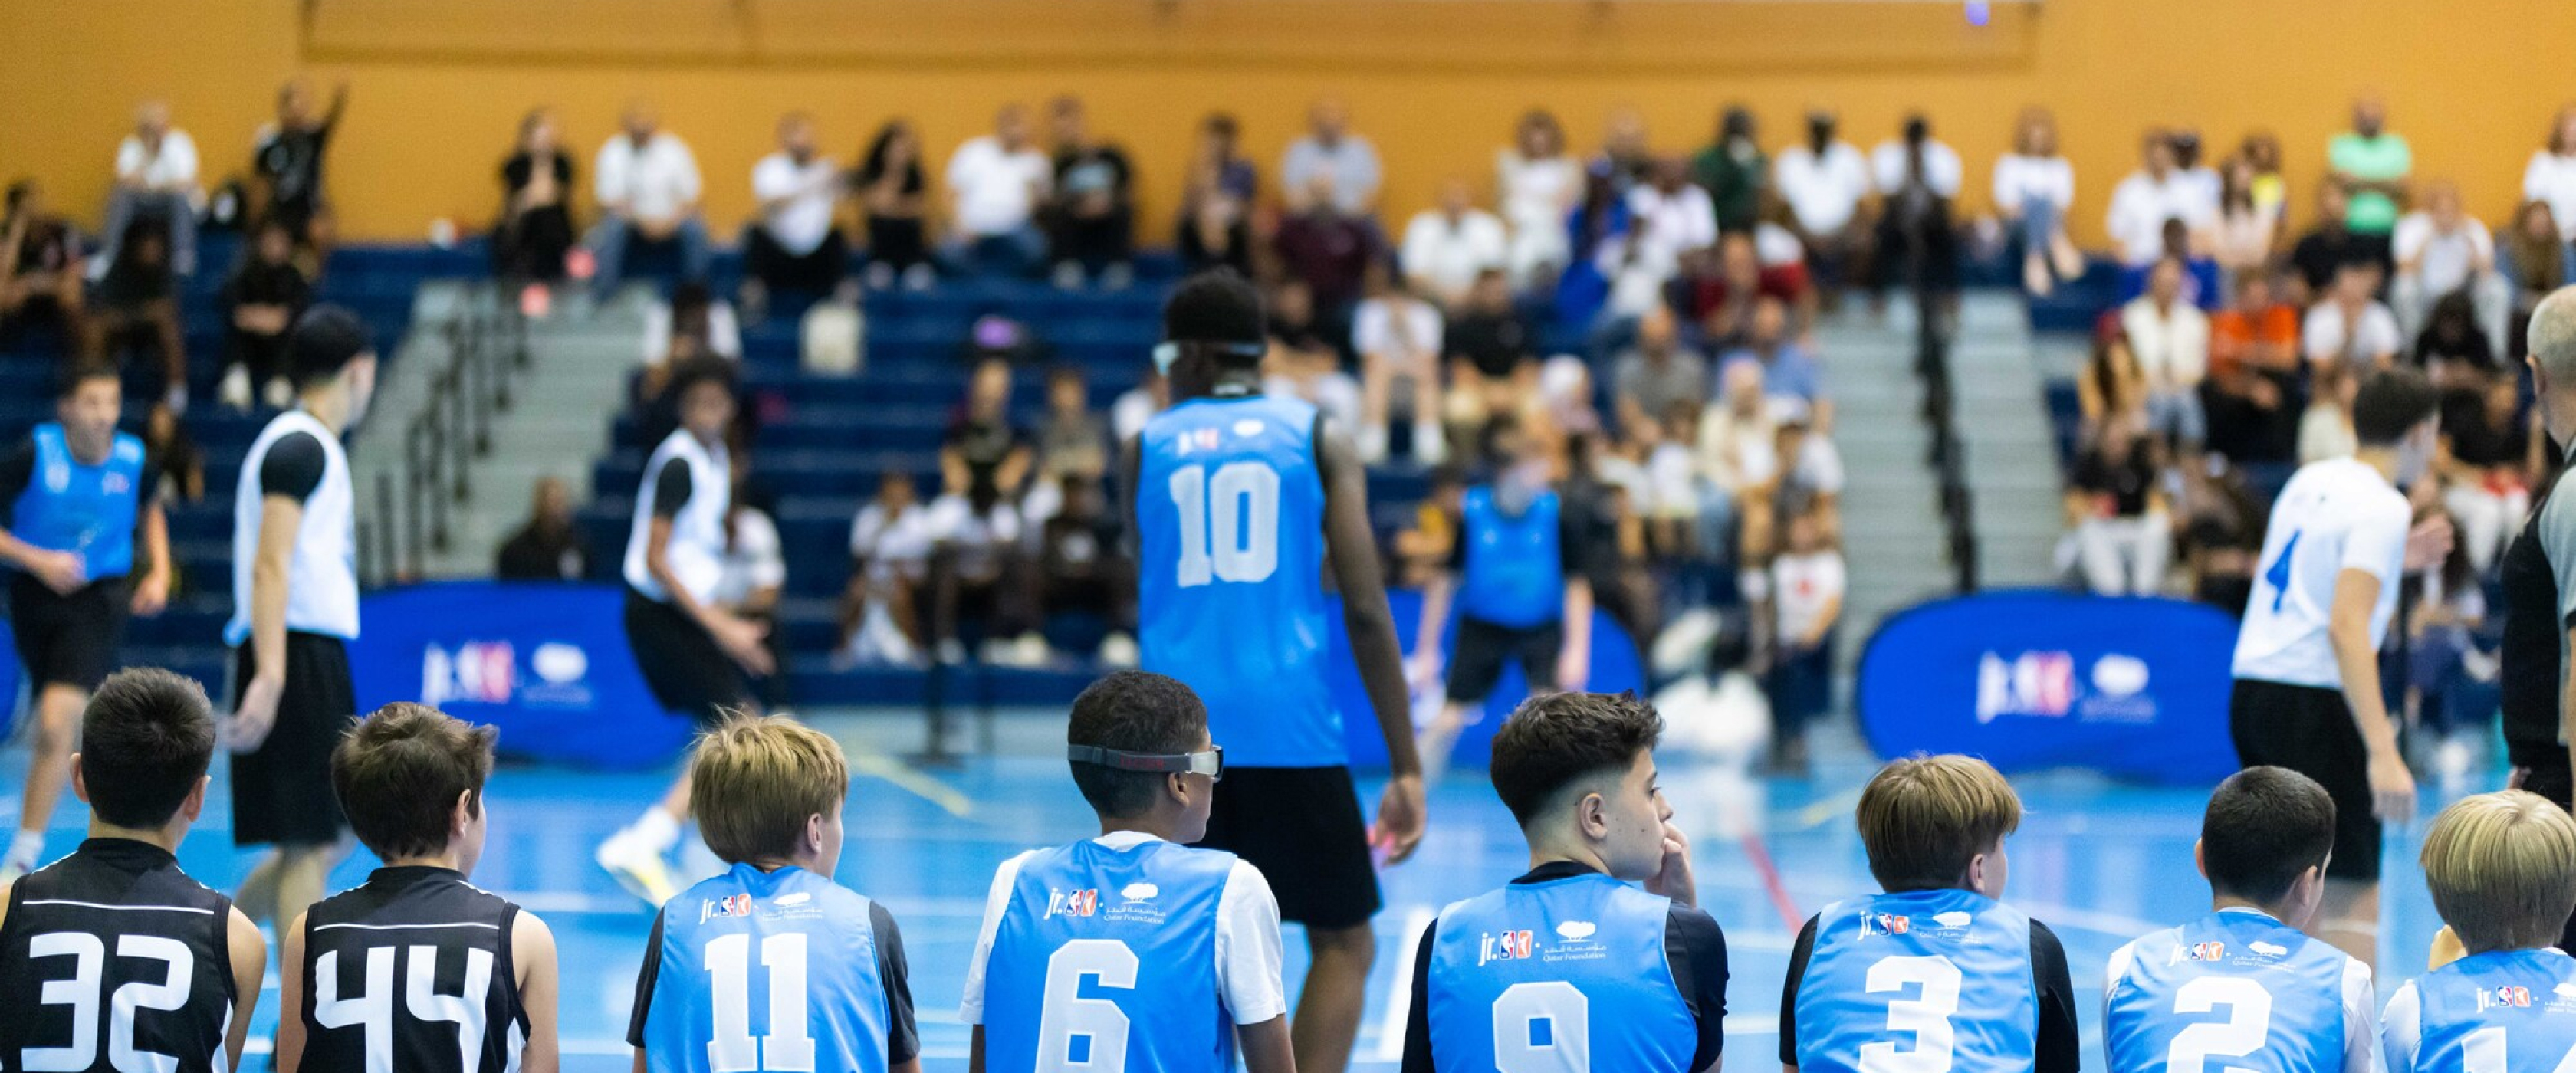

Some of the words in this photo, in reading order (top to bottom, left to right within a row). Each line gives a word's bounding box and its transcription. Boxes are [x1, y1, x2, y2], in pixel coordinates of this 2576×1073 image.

[1168, 462, 1280, 588] 10
[2265, 527, 2303, 615] 4
[699, 897, 718, 925] jr.
[1043, 887, 1065, 920] jr.
[1477, 931, 1498, 967] jr.
[1857, 910, 1877, 941] jr.
[21, 931, 194, 1073] 32
[704, 932, 816, 1073] 11
[1565, 952, 1606, 960] Foundation
[314, 944, 495, 1073] 44
[1034, 938, 1140, 1073] 6
[1493, 980, 1590, 1073] 9
[1858, 955, 1963, 1073] 3
[2167, 976, 2272, 1073] 2
